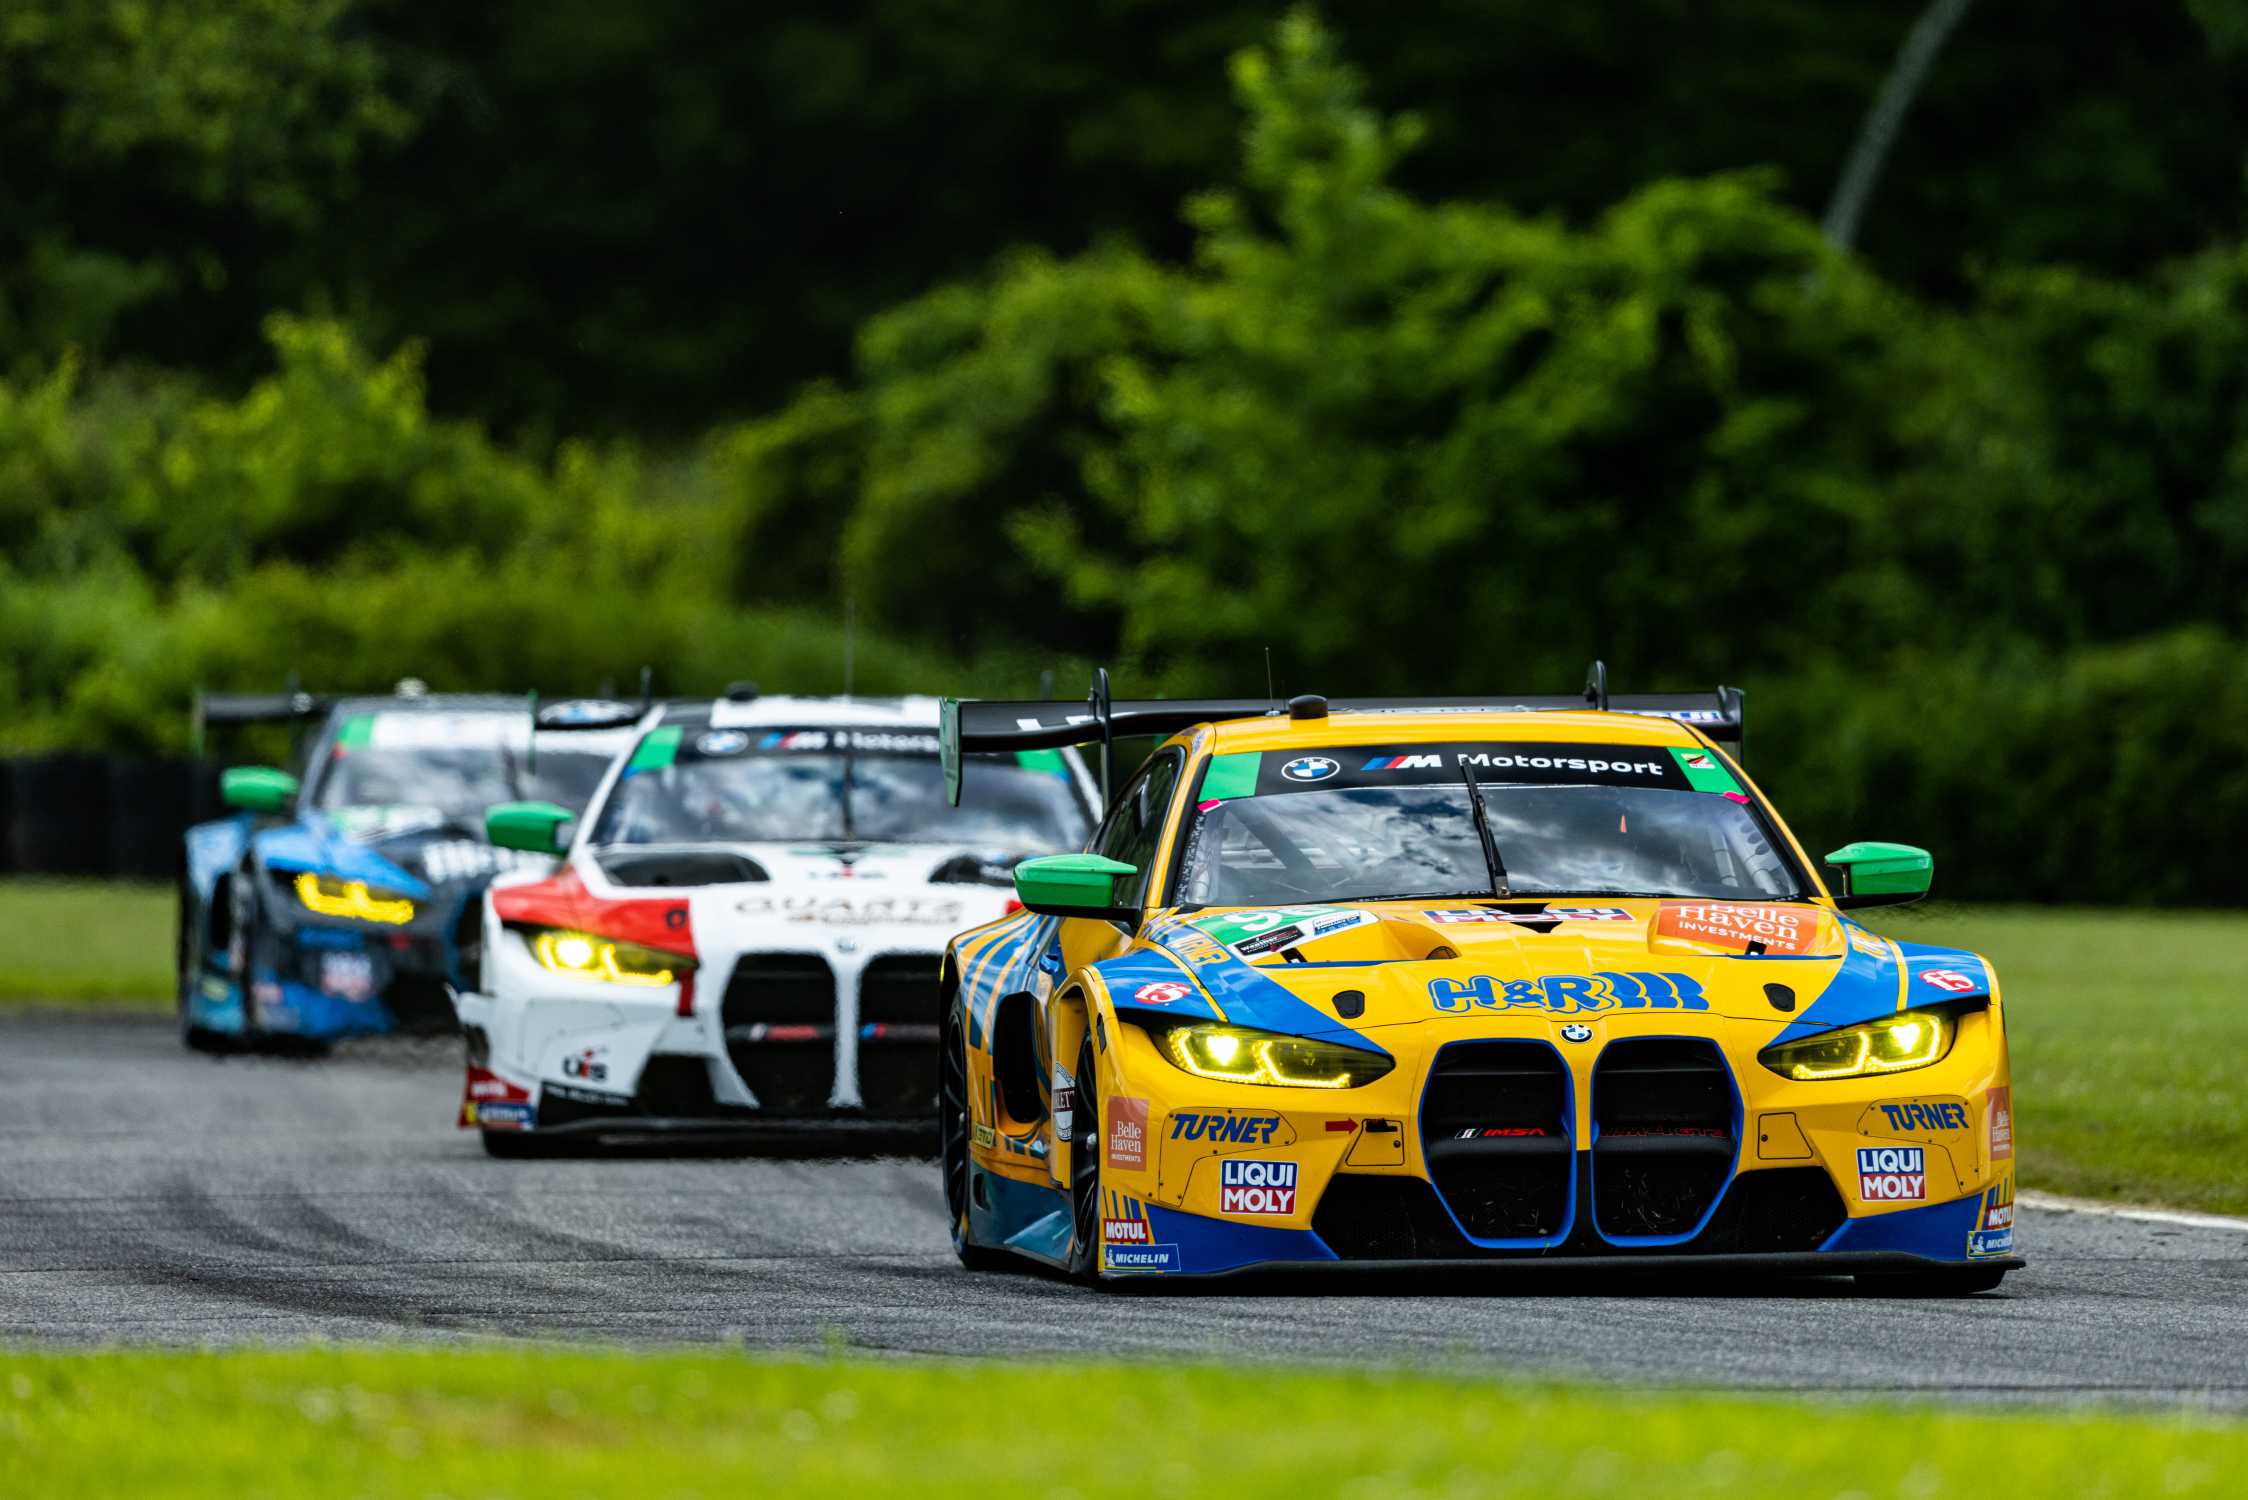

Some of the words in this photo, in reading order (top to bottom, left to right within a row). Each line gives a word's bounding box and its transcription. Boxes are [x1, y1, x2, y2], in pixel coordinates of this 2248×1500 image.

[1457, 753, 1663, 775] Motorsport
[1676, 906, 1799, 941] Haven
[1710, 904, 1799, 927] Belle
[1678, 920, 1796, 951] INVESTMENTS
[1428, 975, 1616, 1014] H&R
[1170, 1113, 1281, 1144] TURNER
[1880, 1103, 1970, 1131] TURNER
[1117, 1120, 1142, 1139] Belle
[1483, 1128, 1546, 1137] IMSA
[1111, 1134, 1142, 1153] Haven
[1860, 1149, 1922, 1174] LIQUI
[1224, 1162, 1294, 1187] LIQUI
[1862, 1174, 1924, 1198] MOLY
[1223, 1188, 1295, 1212] MOLY
[1105, 1221, 1146, 1240] MOTUL
[1115, 1253, 1169, 1264] MICHELIN
